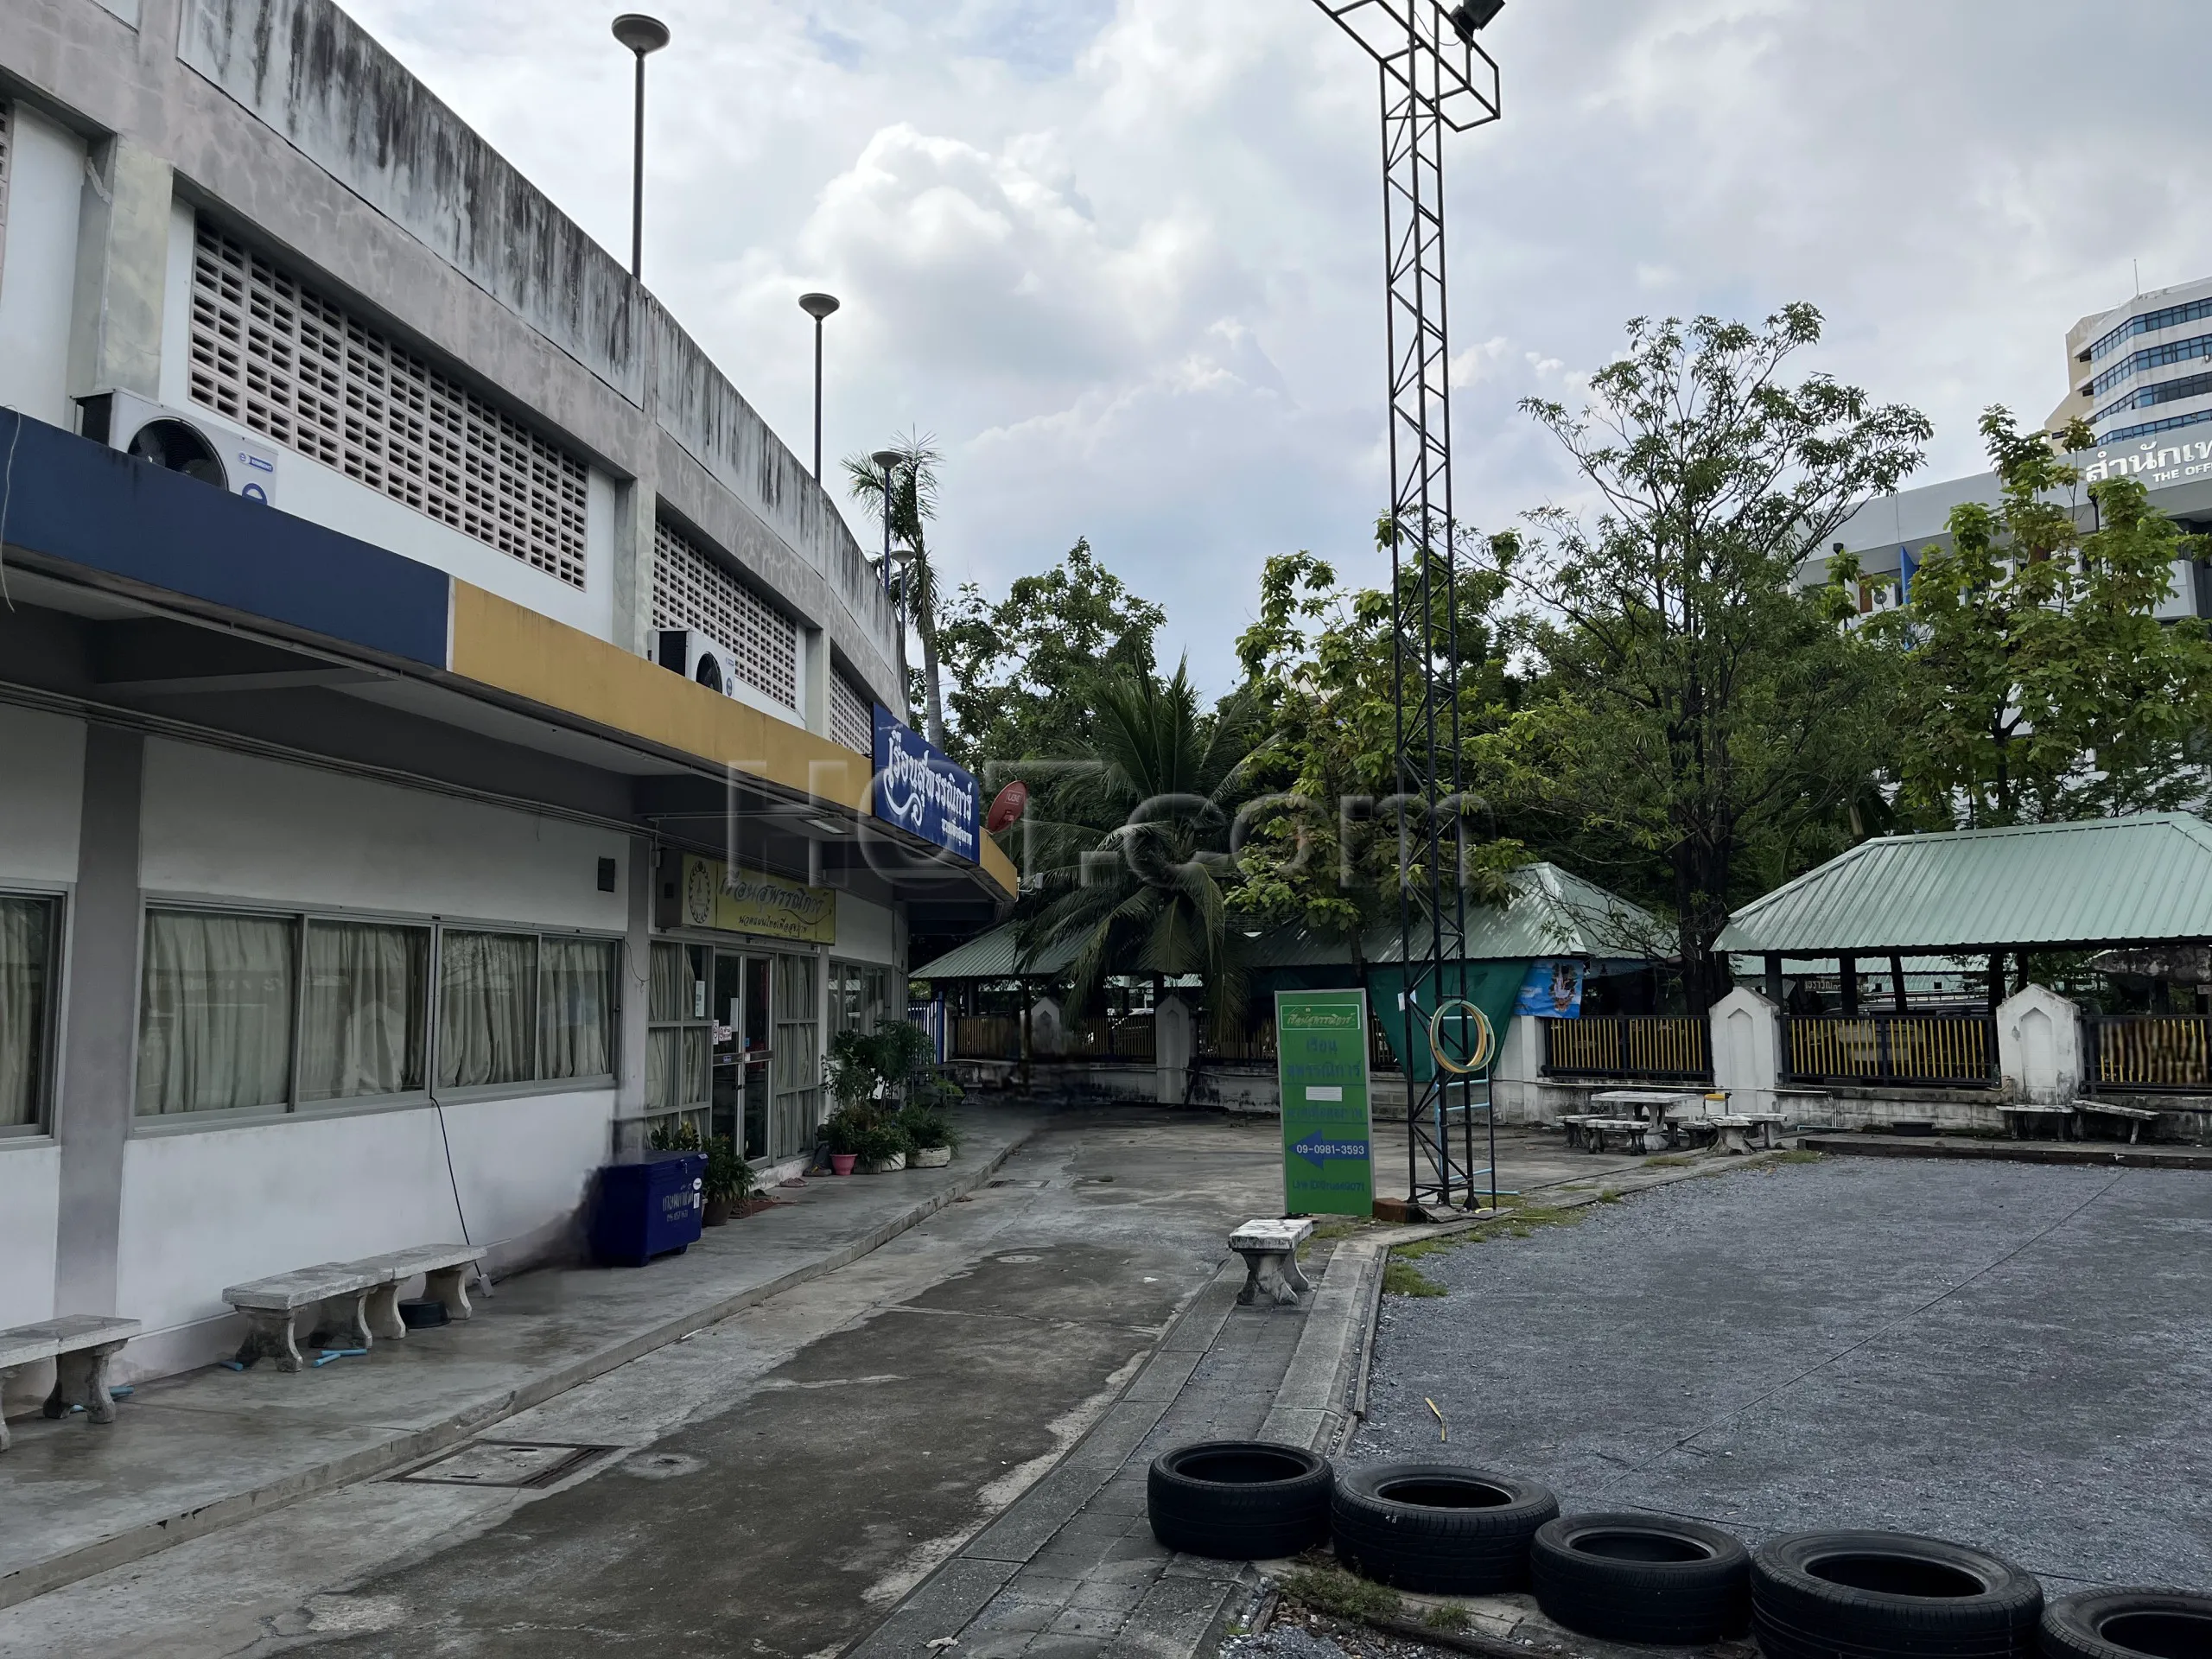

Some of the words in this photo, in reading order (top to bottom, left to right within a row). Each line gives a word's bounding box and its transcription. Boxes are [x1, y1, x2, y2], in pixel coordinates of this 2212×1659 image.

[2152, 469, 2180, 483] THE
[2184, 462, 2212, 476] OFF
[1296, 1144, 1365, 1155] 09-0981-3593
